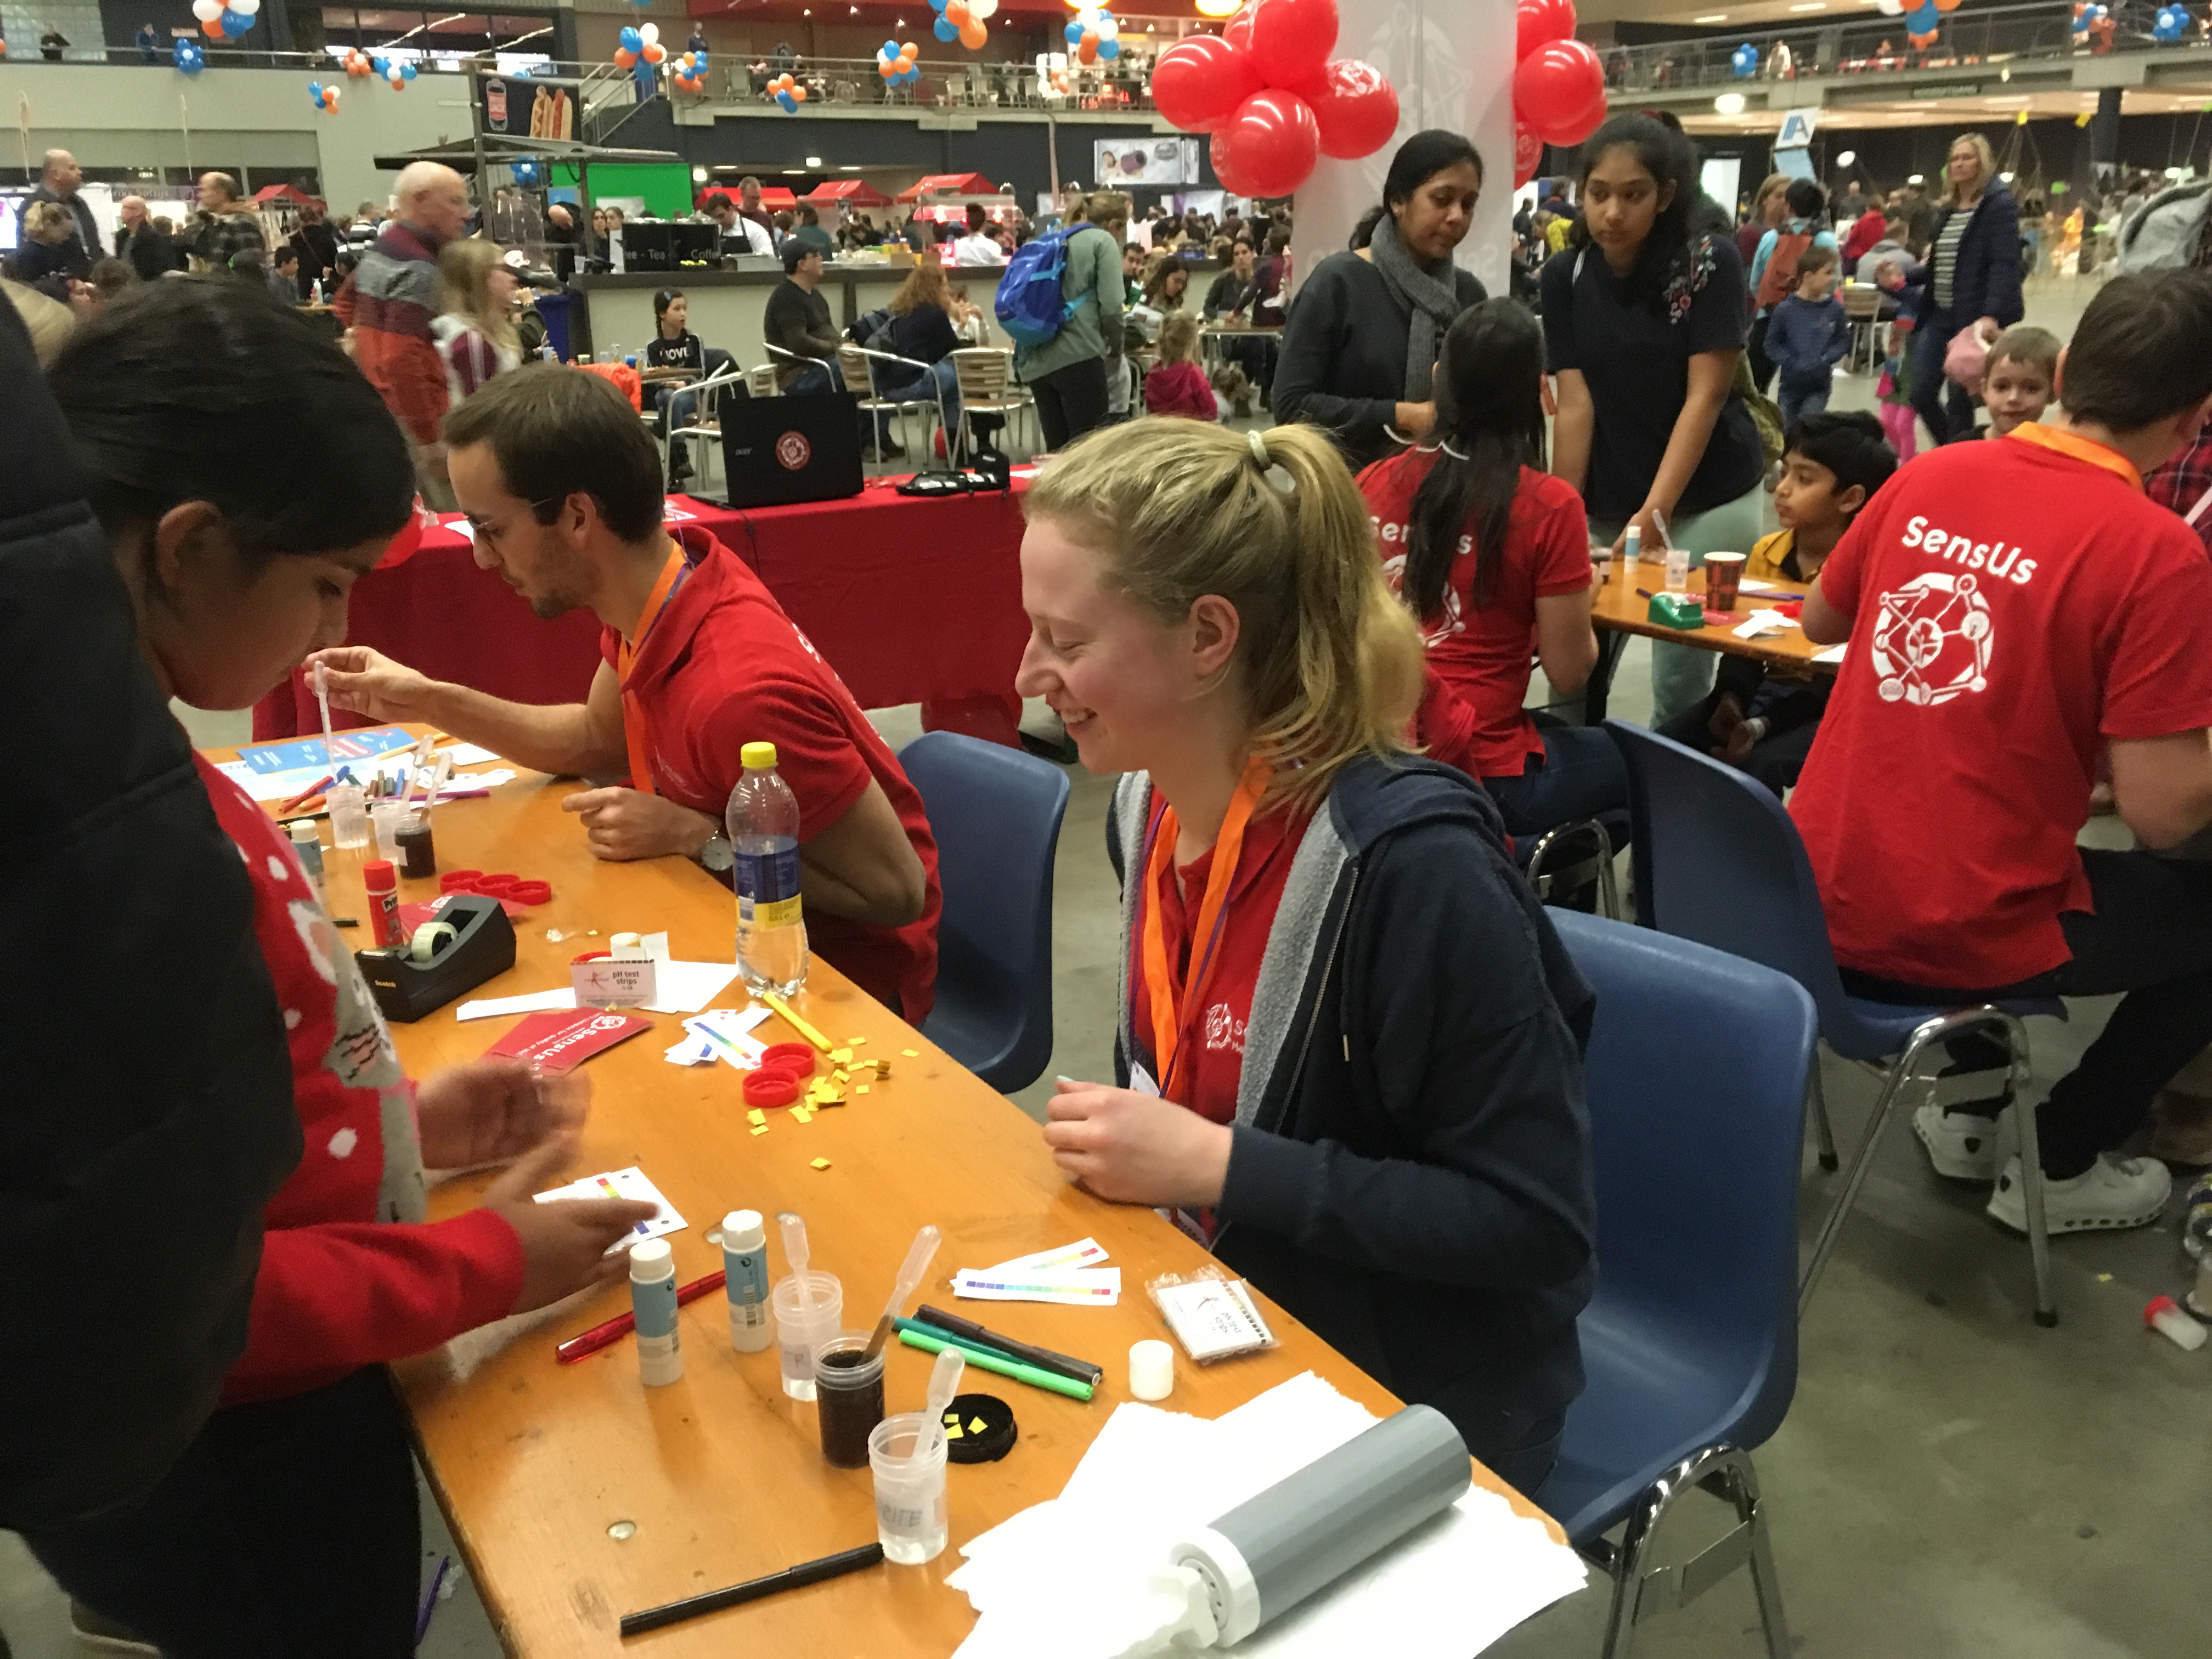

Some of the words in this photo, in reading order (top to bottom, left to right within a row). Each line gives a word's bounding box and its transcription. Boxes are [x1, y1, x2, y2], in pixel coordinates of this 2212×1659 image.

[647, 249, 665, 259] Tea
[1901, 516, 2038, 585] SensUs
[533, 1029, 597, 1060] SensUs
